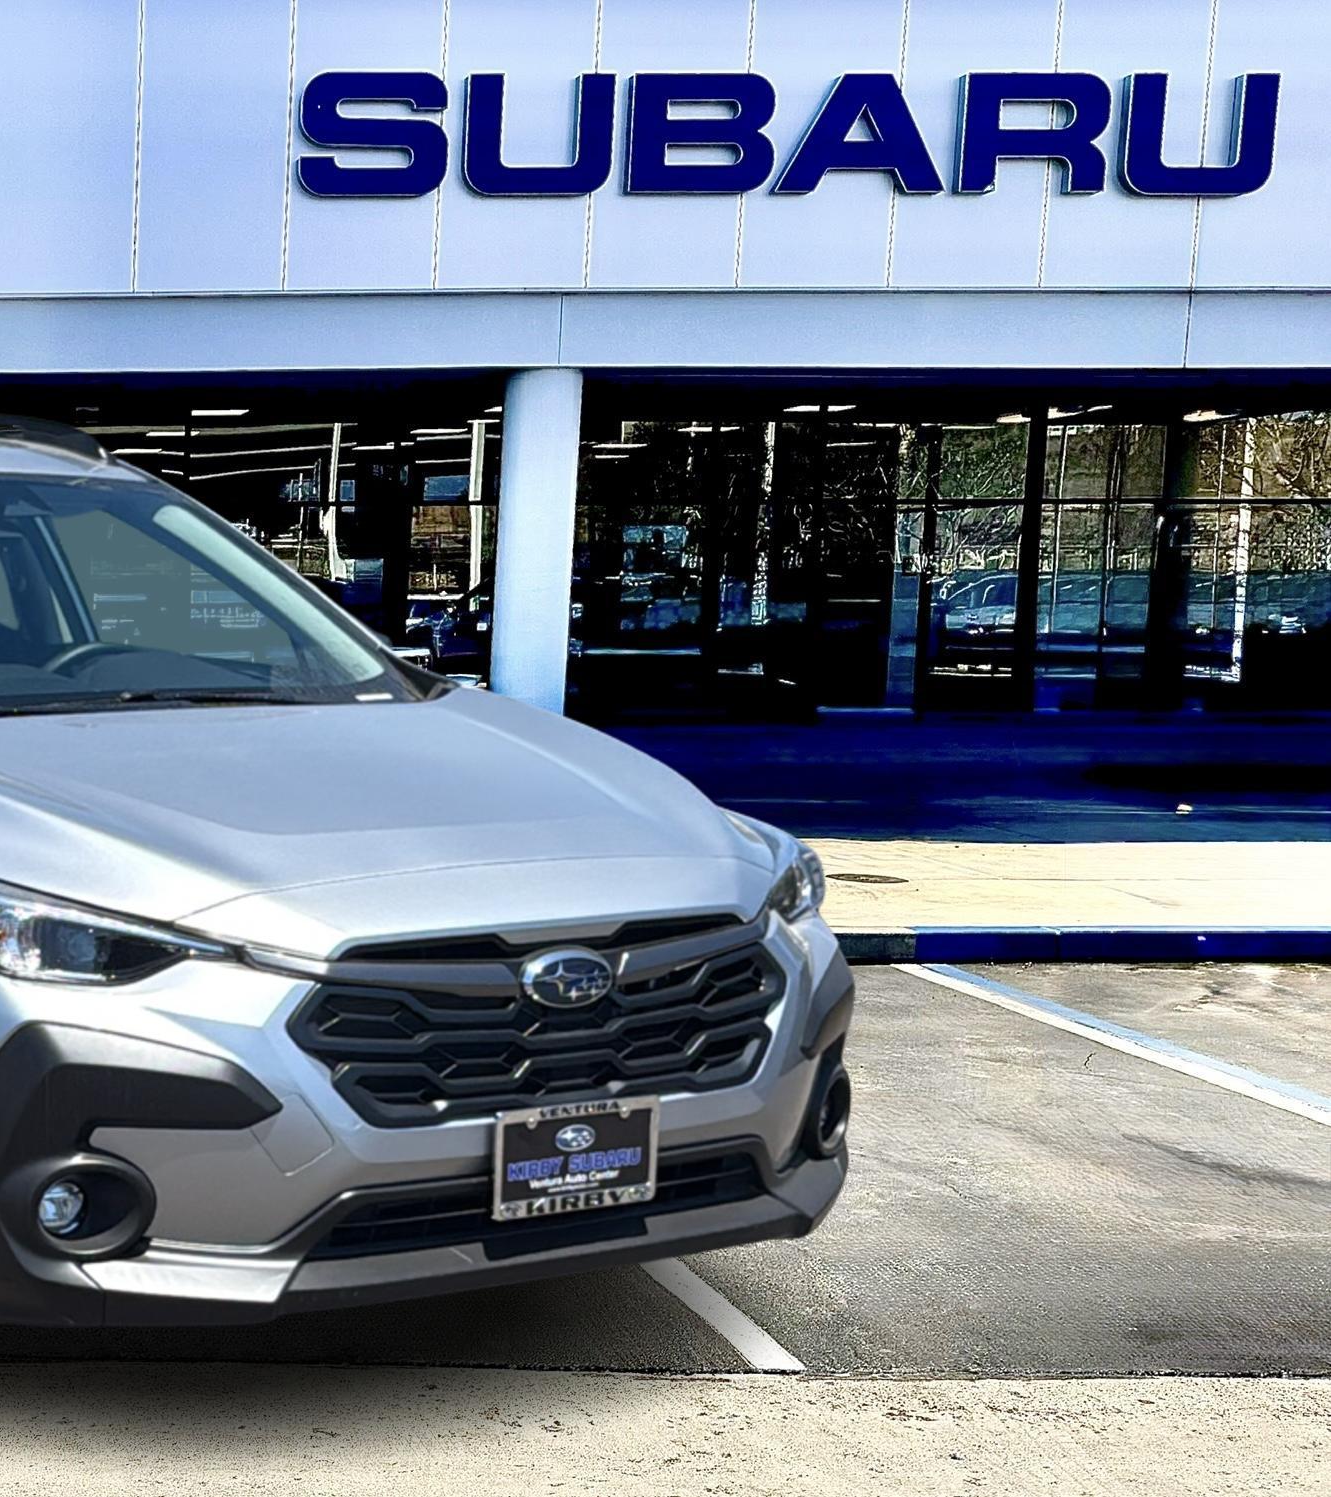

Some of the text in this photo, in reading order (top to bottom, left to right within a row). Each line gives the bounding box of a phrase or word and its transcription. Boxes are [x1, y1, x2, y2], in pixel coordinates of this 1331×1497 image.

[296, 71, 1282, 198] SUBARU
[539, 1101, 620, 1118] VENTURA
[507, 1147, 641, 1181] KIRBY SUBARU
[529, 1177, 563, 1189] Ventura
[564, 1173, 588, 1183] Auto
[526, 1191, 624, 1215] KIRBY
